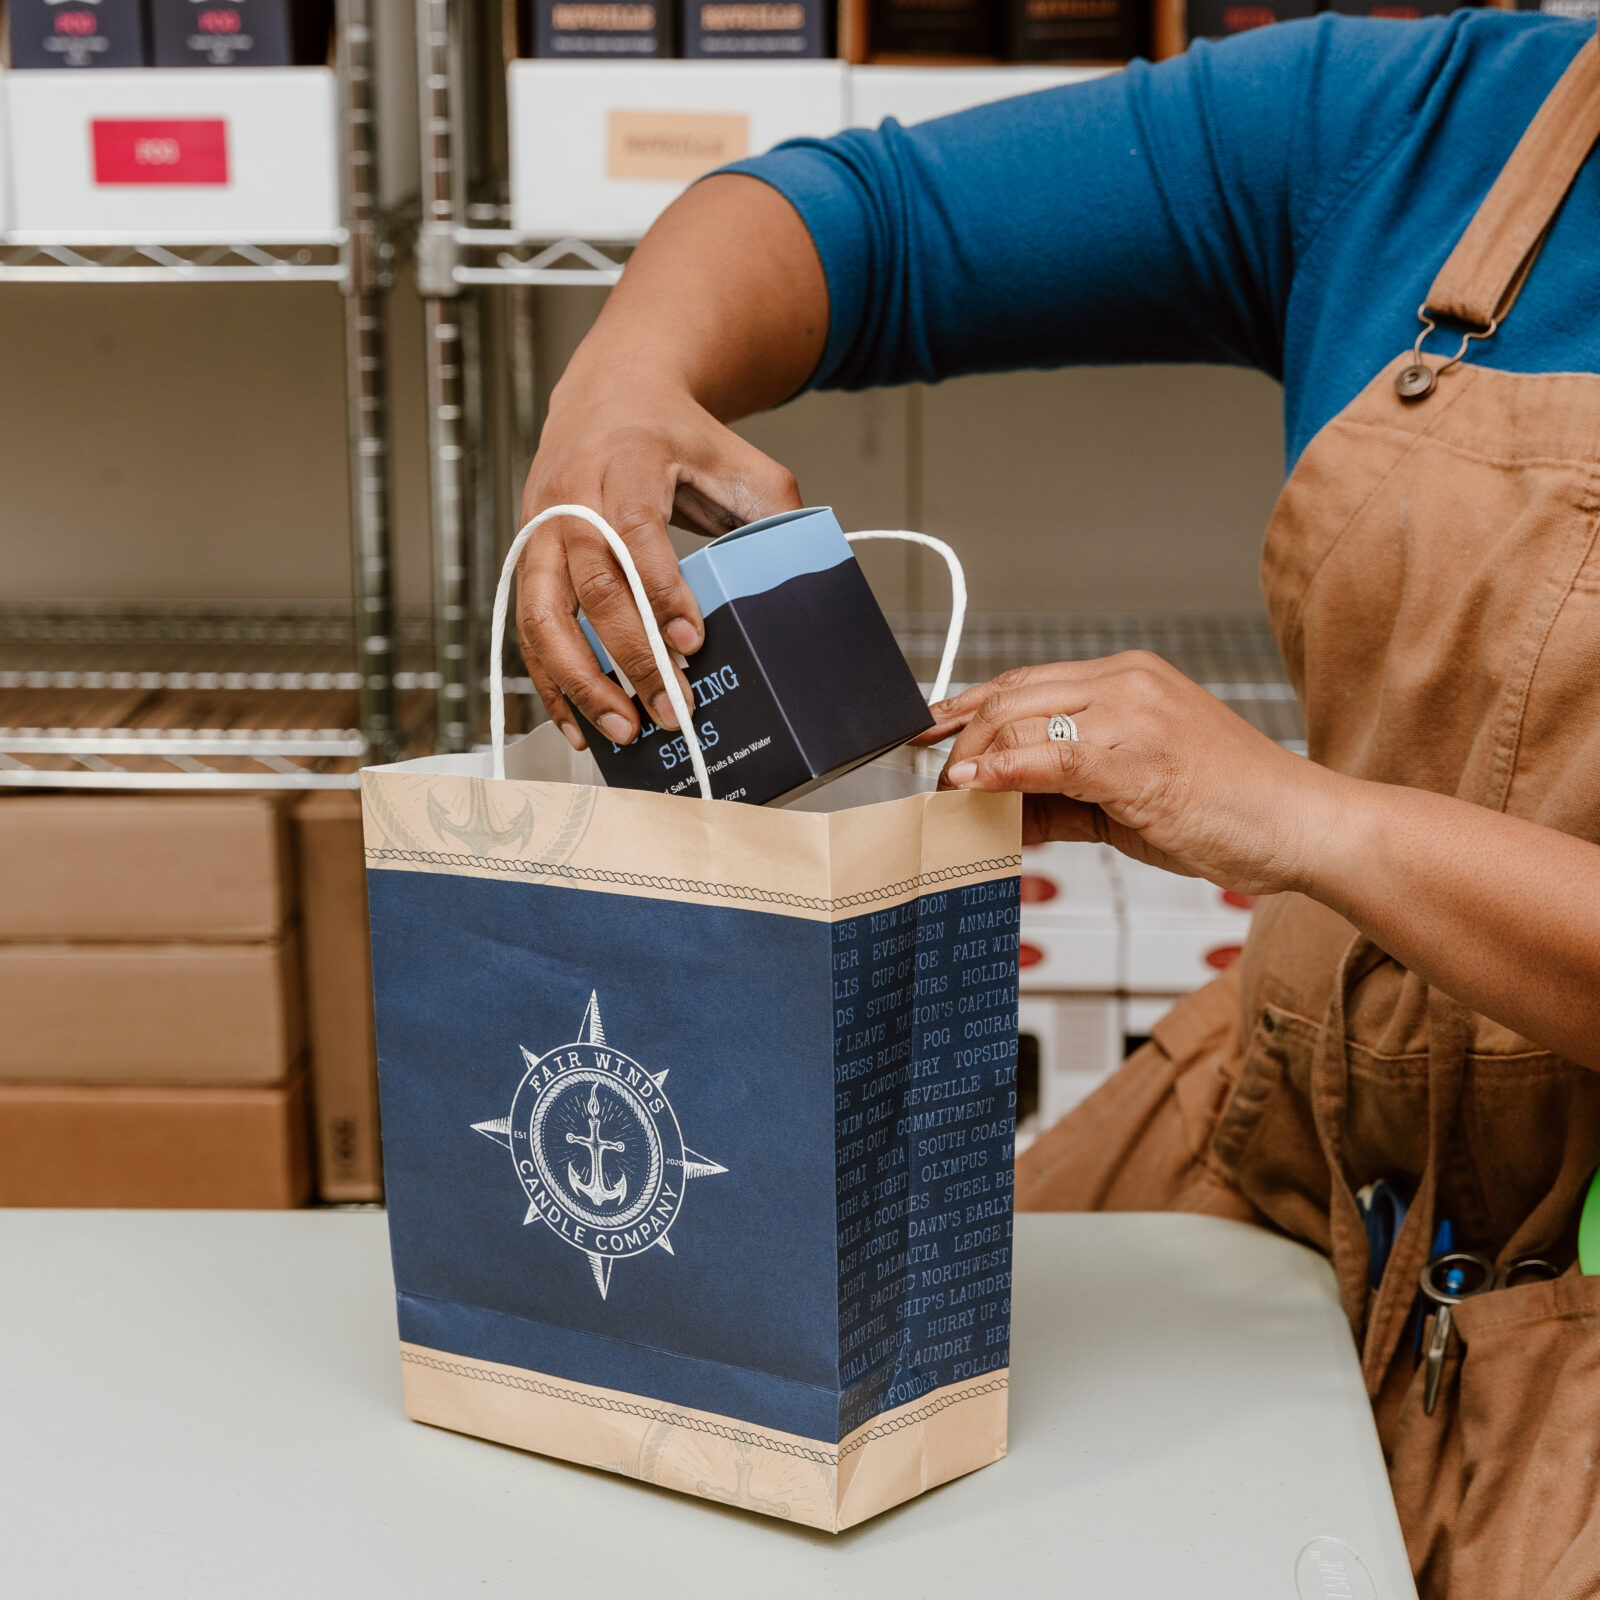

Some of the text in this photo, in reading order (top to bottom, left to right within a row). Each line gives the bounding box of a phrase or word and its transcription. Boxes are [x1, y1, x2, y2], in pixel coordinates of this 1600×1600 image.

[659, 720, 720, 770] SES
[706, 760, 728, 775] Fruits
[727, 755, 735, 764] &
[733, 748, 750, 761] Rain
[749, 736, 772, 752] Water
[833, 922, 856, 942] ES
[870, 910, 896, 934] NEW
[959, 907, 1020, 934] ANNAPOL
[834, 933, 1020, 1000] LIS CUP OF JOE FAIR WIN
[836, 960, 1016, 1028] DS STUDY HOURS HOLIDA
[846, 1023, 886, 1052] LEAVE
[958, 986, 1019, 1014] CAPITAL
[862, 1056, 940, 1101] LOWCOUNTRY
[954, 1039, 1018, 1069] TOPSIDE
[877, 1039, 911, 1069] BLUES
[923, 1028, 950, 1049] POG
[529, 1051, 665, 1114] FAIR WINDS
[867, 1099, 893, 1124] CALL
[903, 1075, 981, 1108] REVEILLE
[867, 1127, 888, 1151] OUT
[897, 1097, 995, 1136] COMMITMENT
[877, 1147, 905, 1173] ROTA
[918, 1130, 966, 1157] SOUTH
[971, 1117, 1016, 1142] COAST
[665, 1158, 684, 1167] 2020
[862, 1191, 870, 1208] &
[872, 1172, 909, 1201] TIGHT
[922, 1151, 987, 1183] OLYMPUS
[520, 1160, 678, 1251] CANDLE COMPANY
[864, 1217, 872, 1233] &
[874, 1192, 930, 1227] COOKIES
[944, 1175, 991, 1203] STEEL
[996, 1170, 1014, 1189] BE
[840, 1195, 1012, 1276] ACH PICNIC DAWN'S EARLY
[877, 1242, 939, 1281] DALMATIA
[954, 1224, 1000, 1252] LEDGE
[871, 1274, 915, 1312] PACIFIC
[922, 1248, 1009, 1288] NORTHWEST
[896, 1293, 944, 1321] SHIP'S
[950, 1272, 1012, 1306] LAUNDRY
[870, 1327, 911, 1365] LUMPUR
[928, 1308, 976, 1338] HURRY
[980, 1302, 997, 1321] UP
[1002, 1297, 1011, 1314] &
[908, 1335, 973, 1369] LAUNDRY
[888, 1370, 938, 1405] FONDER
[953, 1350, 1009, 1380] FOLLOW
